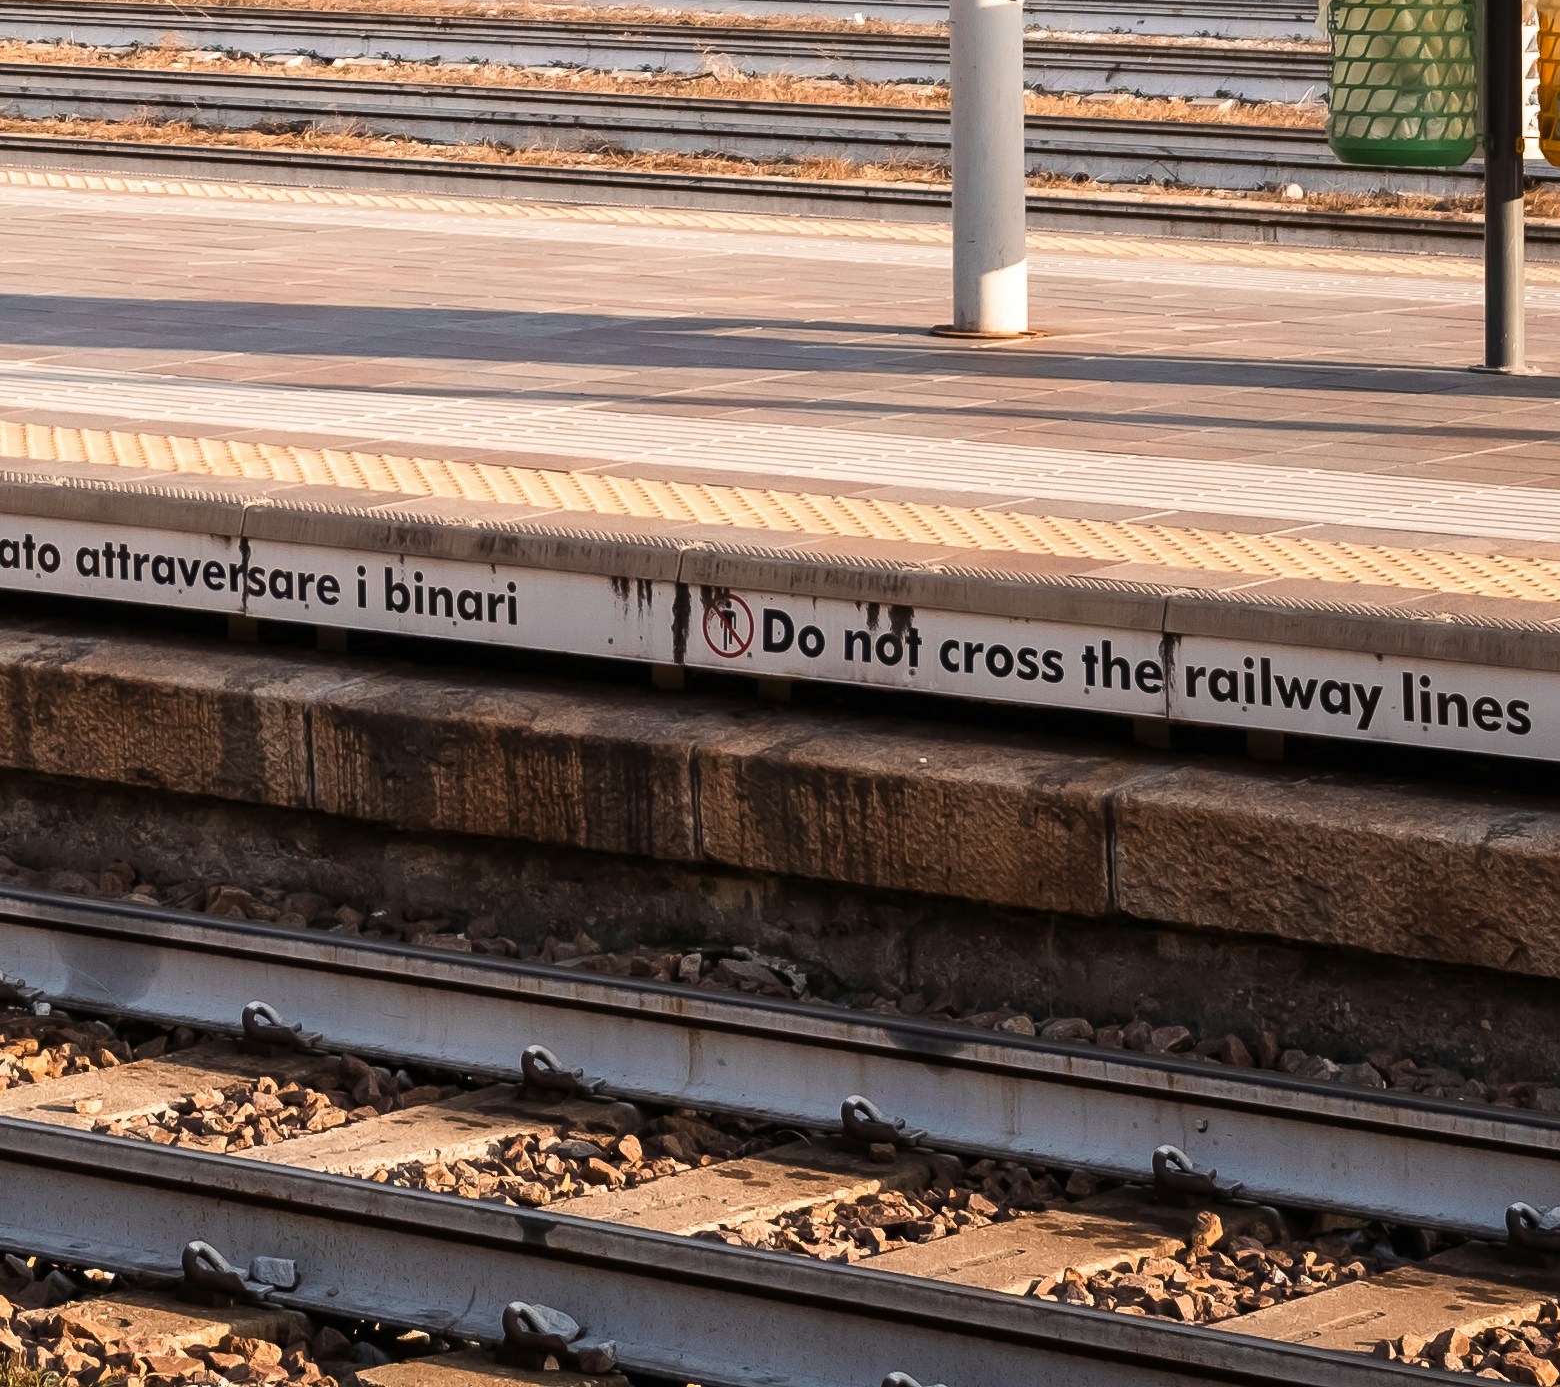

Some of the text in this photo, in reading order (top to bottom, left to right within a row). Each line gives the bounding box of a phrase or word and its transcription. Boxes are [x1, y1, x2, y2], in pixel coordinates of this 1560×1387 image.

[76, 541, 341, 605] attraversare
[356, 565, 368, 608] i
[383, 567, 518, 625] binari
[762, 608, 1532, 735] Do not cross the railway lines
